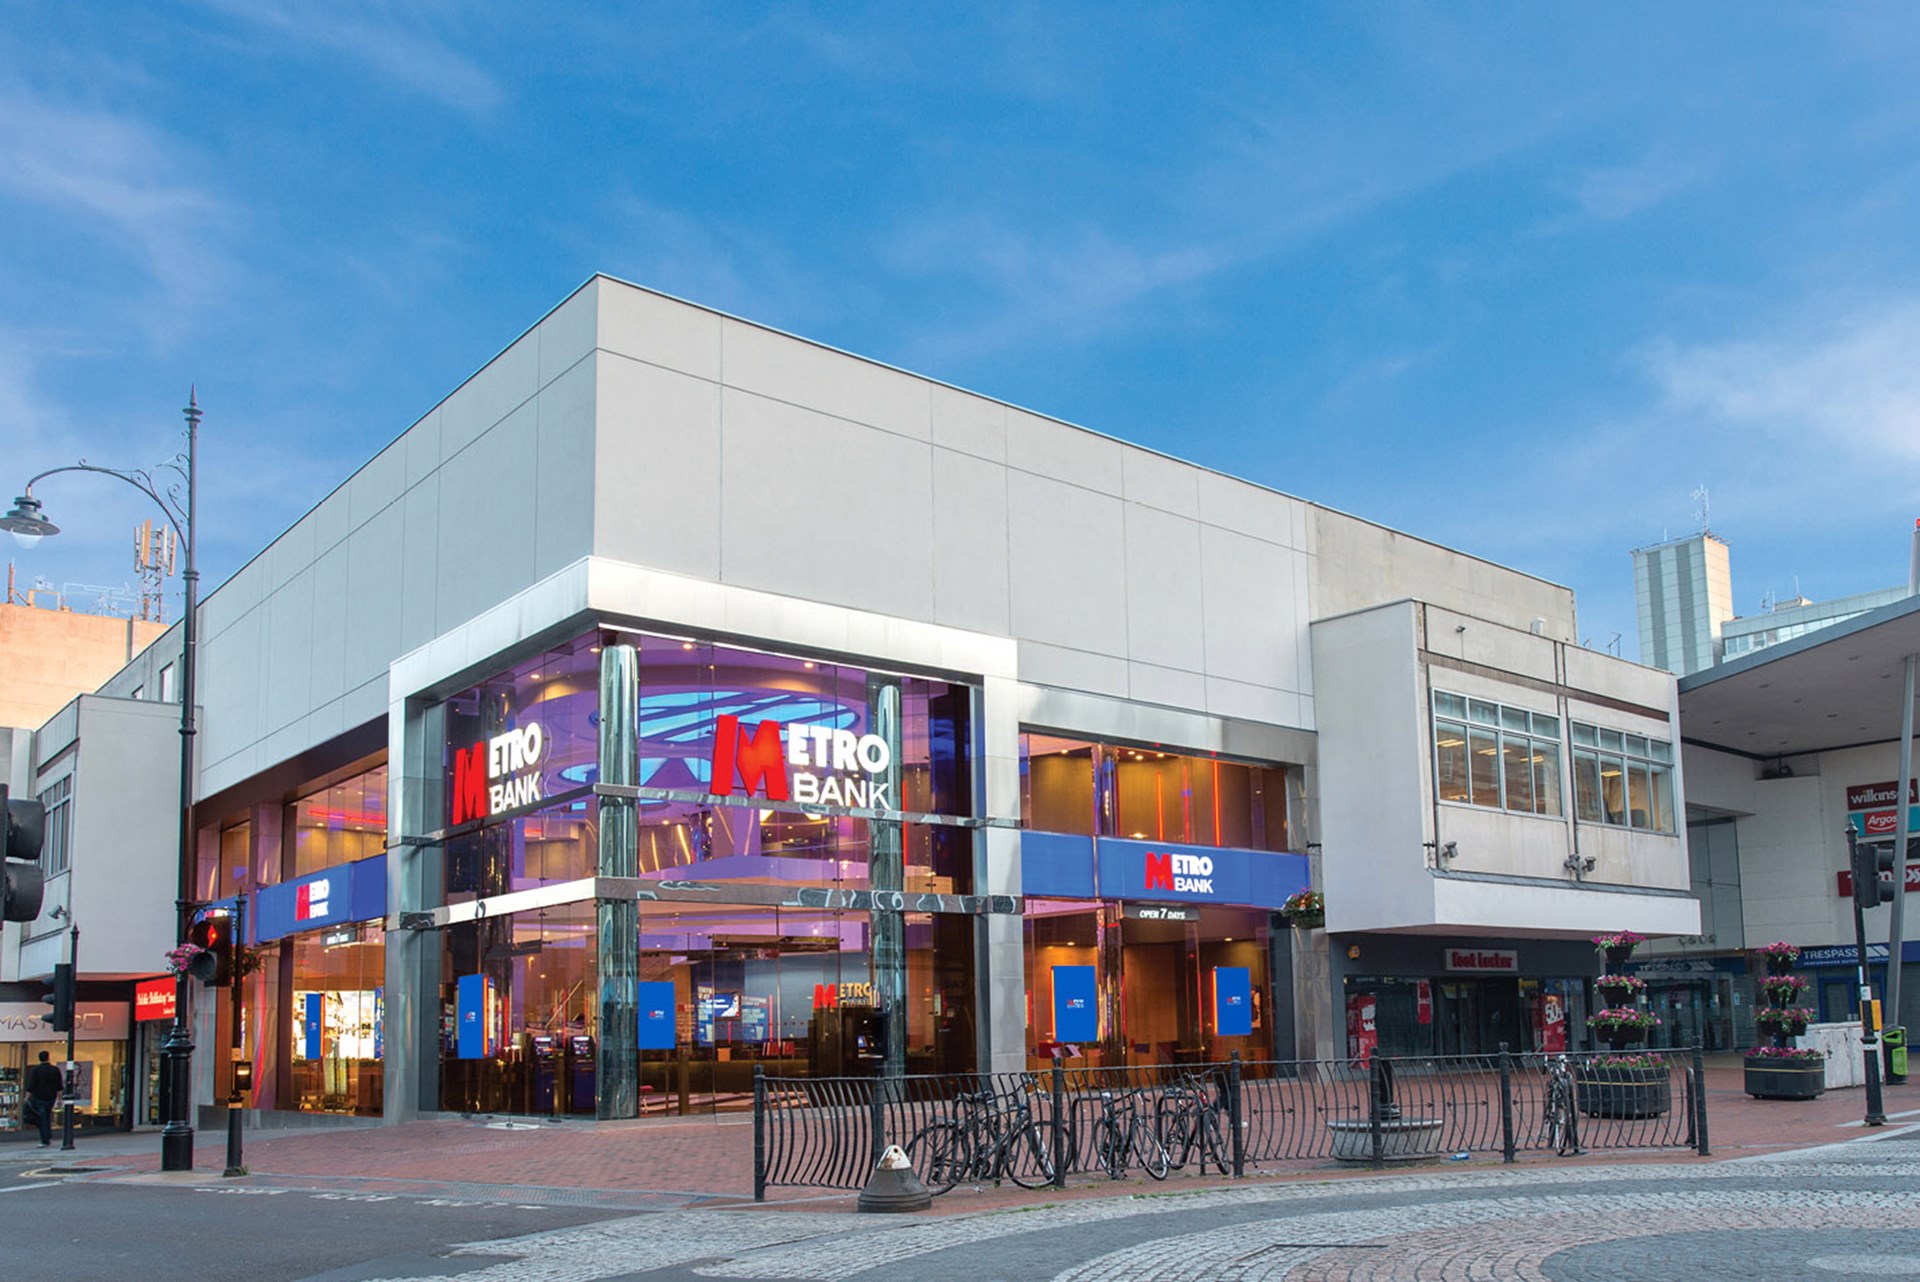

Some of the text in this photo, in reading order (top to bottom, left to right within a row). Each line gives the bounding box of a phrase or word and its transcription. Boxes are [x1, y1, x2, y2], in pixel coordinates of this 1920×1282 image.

[452, 722, 542, 825] METRO
[710, 714, 890, 801] METRO
[489, 771, 541, 815] BANK
[793, 772, 890, 810] BANK
[1851, 789, 1914, 804] wilkinsn
[1144, 852, 1213, 890] METRO
[1174, 877, 1214, 893] BANK
[1139, 908, 1186, 920] OPEN 7 DAYS
[1803, 948, 1859, 959] TRESPASS
